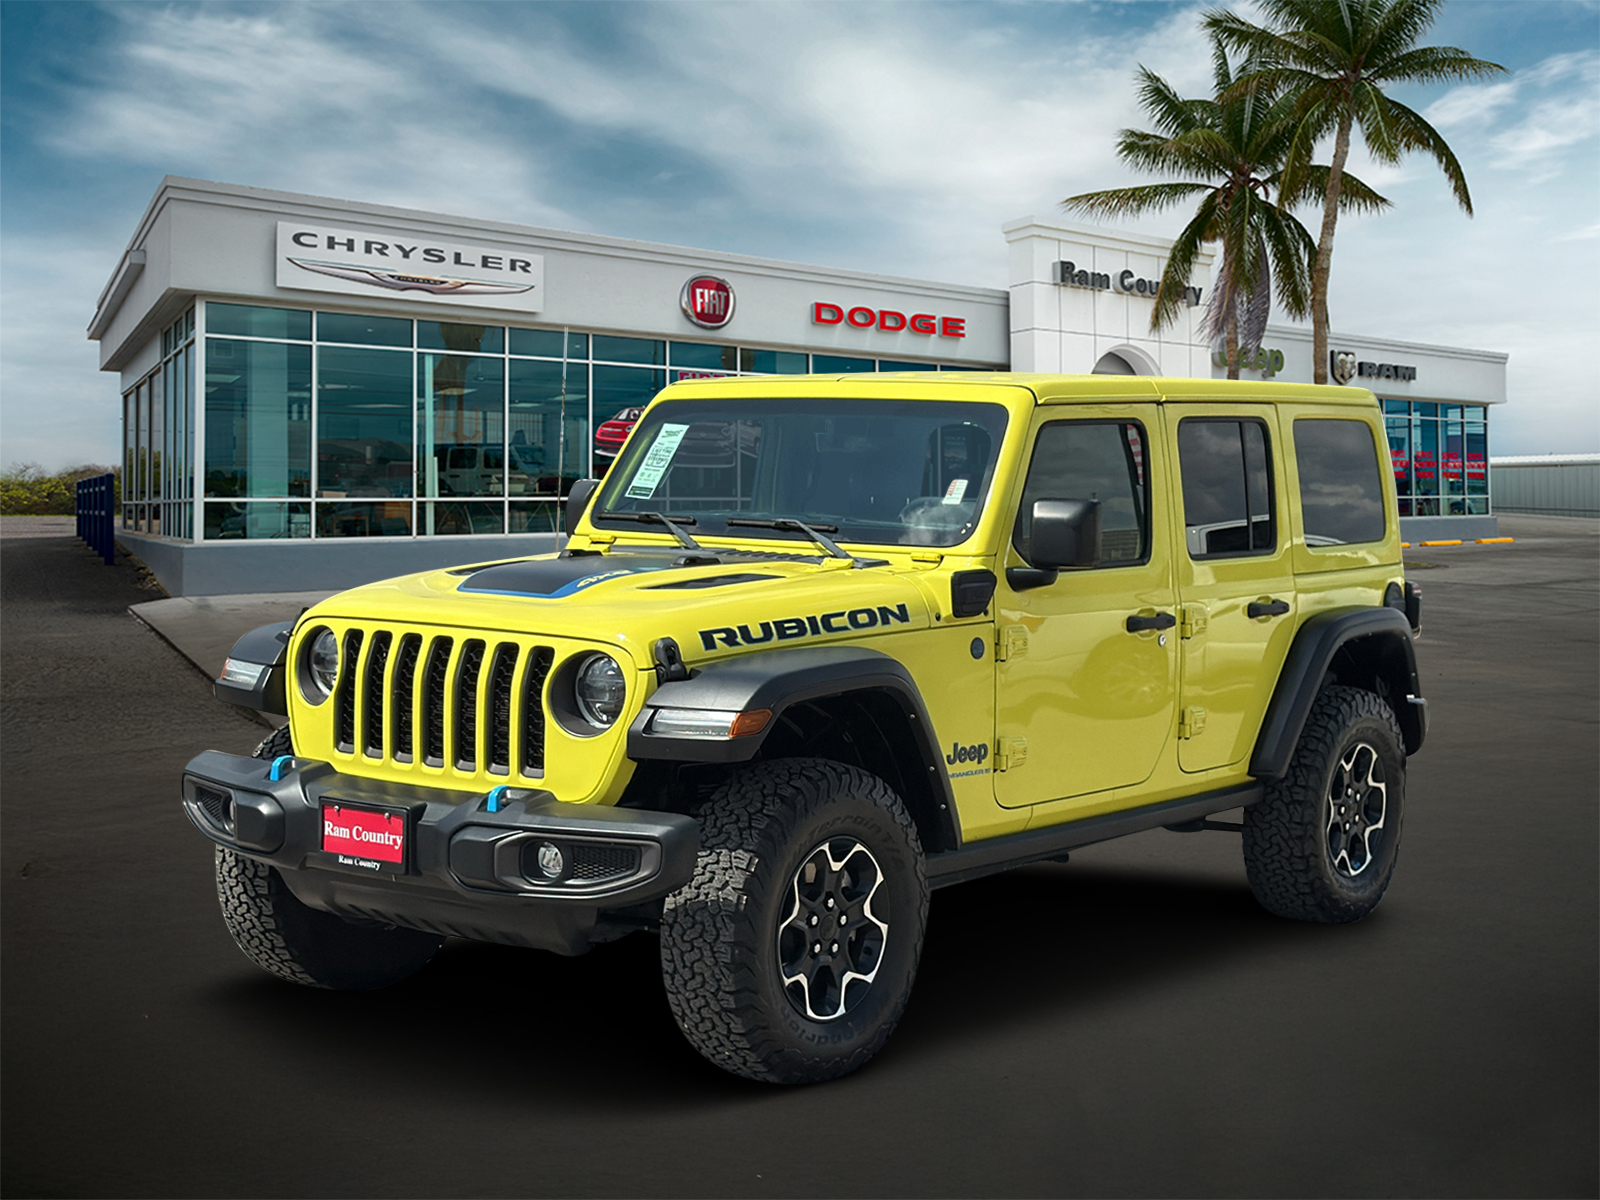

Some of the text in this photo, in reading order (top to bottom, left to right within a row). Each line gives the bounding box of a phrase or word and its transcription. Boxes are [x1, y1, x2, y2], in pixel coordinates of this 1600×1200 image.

[291, 232, 533, 274] CHRYSLER
[1056, 261, 1203, 307] Ram Coury
[695, 288, 727, 316] FIAT
[811, 301, 966, 338] DODGE
[1357, 361, 1417, 381] RAM
[698, 603, 911, 651] RUBICON
[946, 741, 989, 766] Jeep
[324, 820, 404, 850] Ram Country
[338, 855, 381, 871] Ram Country
